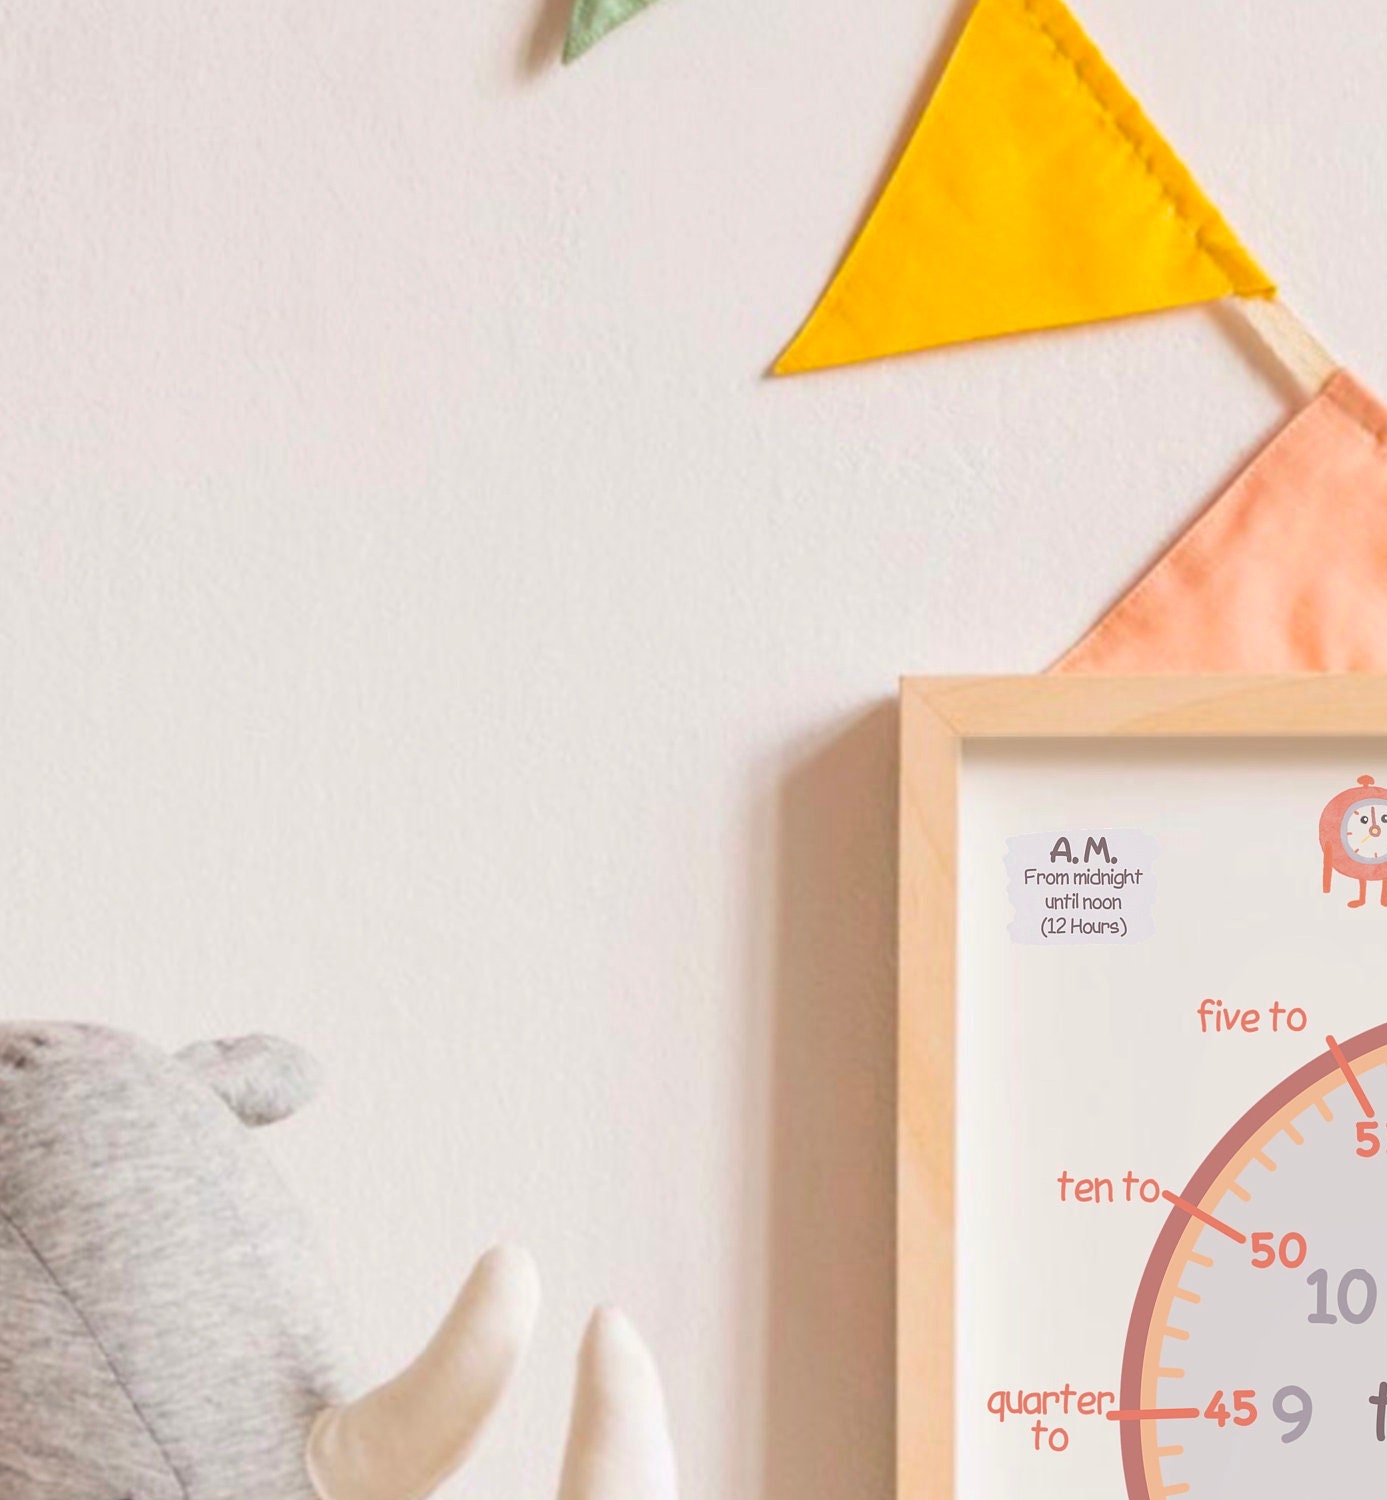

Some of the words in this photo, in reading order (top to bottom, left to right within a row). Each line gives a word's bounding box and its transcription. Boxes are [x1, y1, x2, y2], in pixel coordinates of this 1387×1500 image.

[1050, 837, 1117, 864] A.M.
[1025, 869, 1069, 885] From
[1074, 869, 1143, 889] midnight
[1045, 893, 1078, 909] until
[1083, 897, 1121, 910] noon
[1041, 917, 1066, 938] (12
[1071, 917, 1127, 937] Hours)
[1197, 999, 1260, 1032] five
[1269, 1001, 1307, 1032] to
[1057, 1171, 1113, 1203] ten
[1123, 1171, 1160, 1203] to
[1251, 1232, 1307, 1268] 50
[1307, 1268, 1377, 1324] 10
[987, 1383, 1114, 1422] quarter
[1204, 1390, 1257, 1427] 45
[1273, 1385, 1312, 1443] 9
[1031, 1420, 1068, 1451] to
